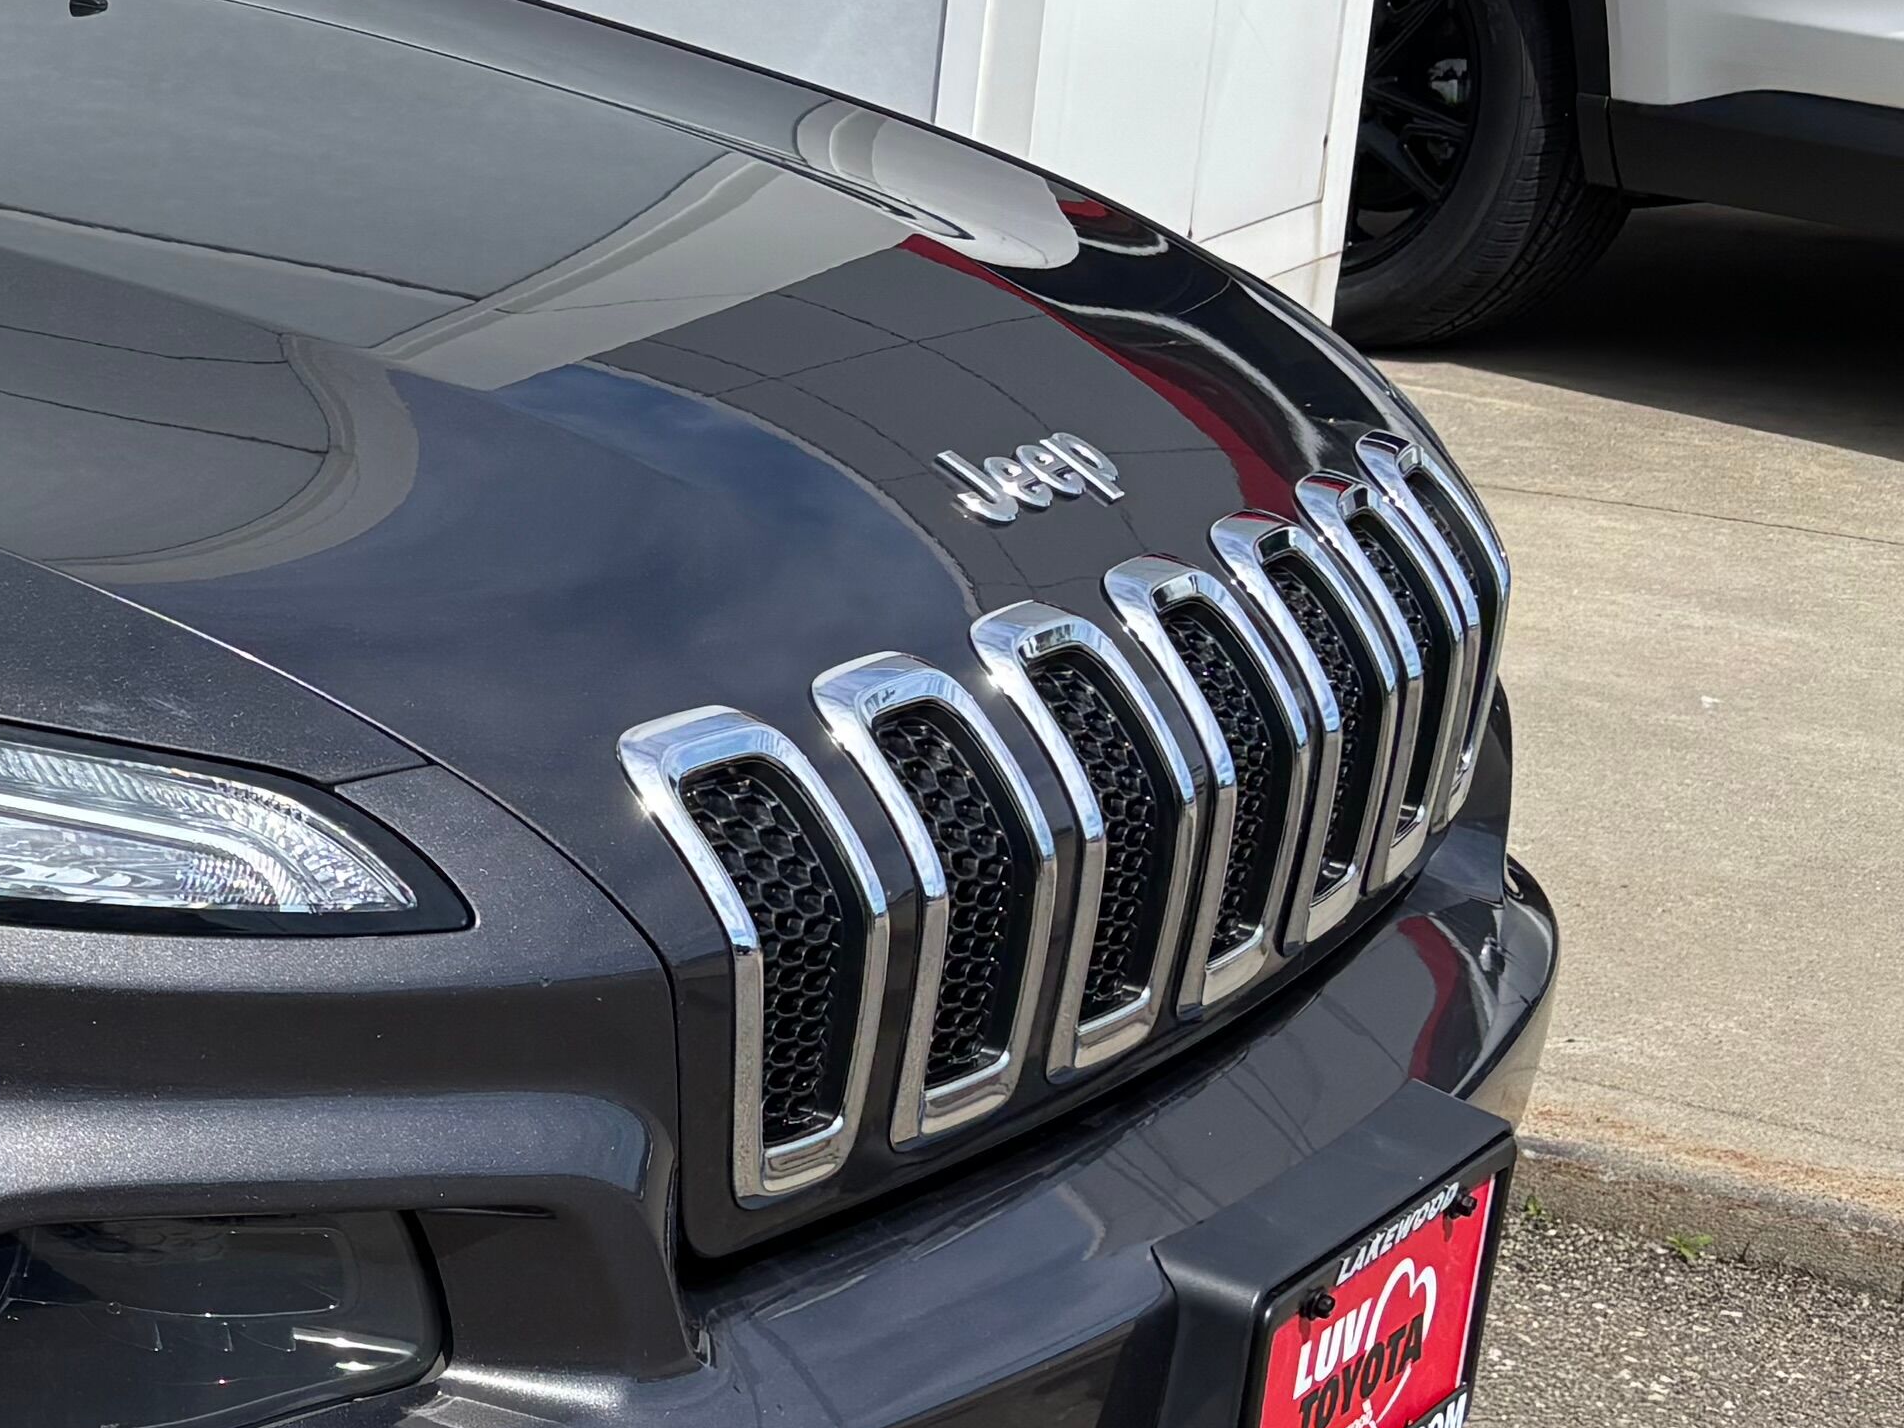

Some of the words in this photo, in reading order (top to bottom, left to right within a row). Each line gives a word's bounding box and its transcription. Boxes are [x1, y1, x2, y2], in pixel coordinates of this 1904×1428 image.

[937, 432, 1125, 522] Jeep
[1335, 1183, 1460, 1287] LAKEWOOD
[1293, 1298, 1374, 1401] LUV
